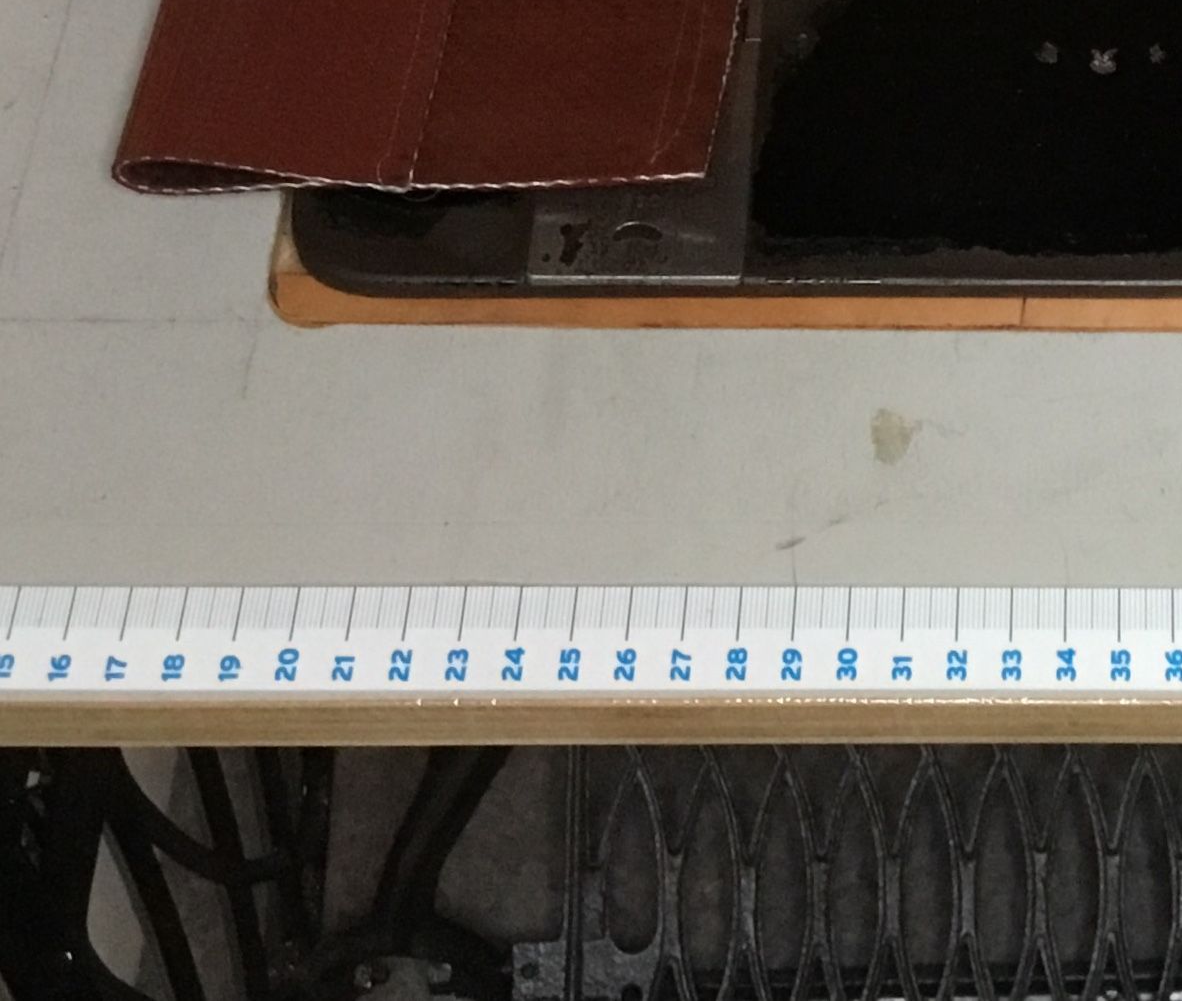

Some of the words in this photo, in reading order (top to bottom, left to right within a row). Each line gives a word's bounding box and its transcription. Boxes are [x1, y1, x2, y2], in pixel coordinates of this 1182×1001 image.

[47, 654, 72, 681] 16
[103, 656, 128, 682] 17
[160, 653, 186, 682] 18
[217, 654, 242, 682] 19
[273, 647, 301, 683] 20
[331, 655, 357, 682] 21
[387, 649, 413, 683] 22
[443, 648, 470, 683] 23
[500, 646, 527, 682] 24
[556, 647, 582, 683] 25
[612, 648, 638, 683] 26
[668, 649, 693, 683] 27
[723, 646, 750, 682] 28
[779, 646, 804, 682] 29
[834, 646, 860, 680] 30
[890, 654, 913, 681] 31
[944, 649, 969, 682] 32
[999, 648, 1024, 681] 33
[1055, 646, 1078, 681] 34
[1109, 648, 1133, 682] 35
